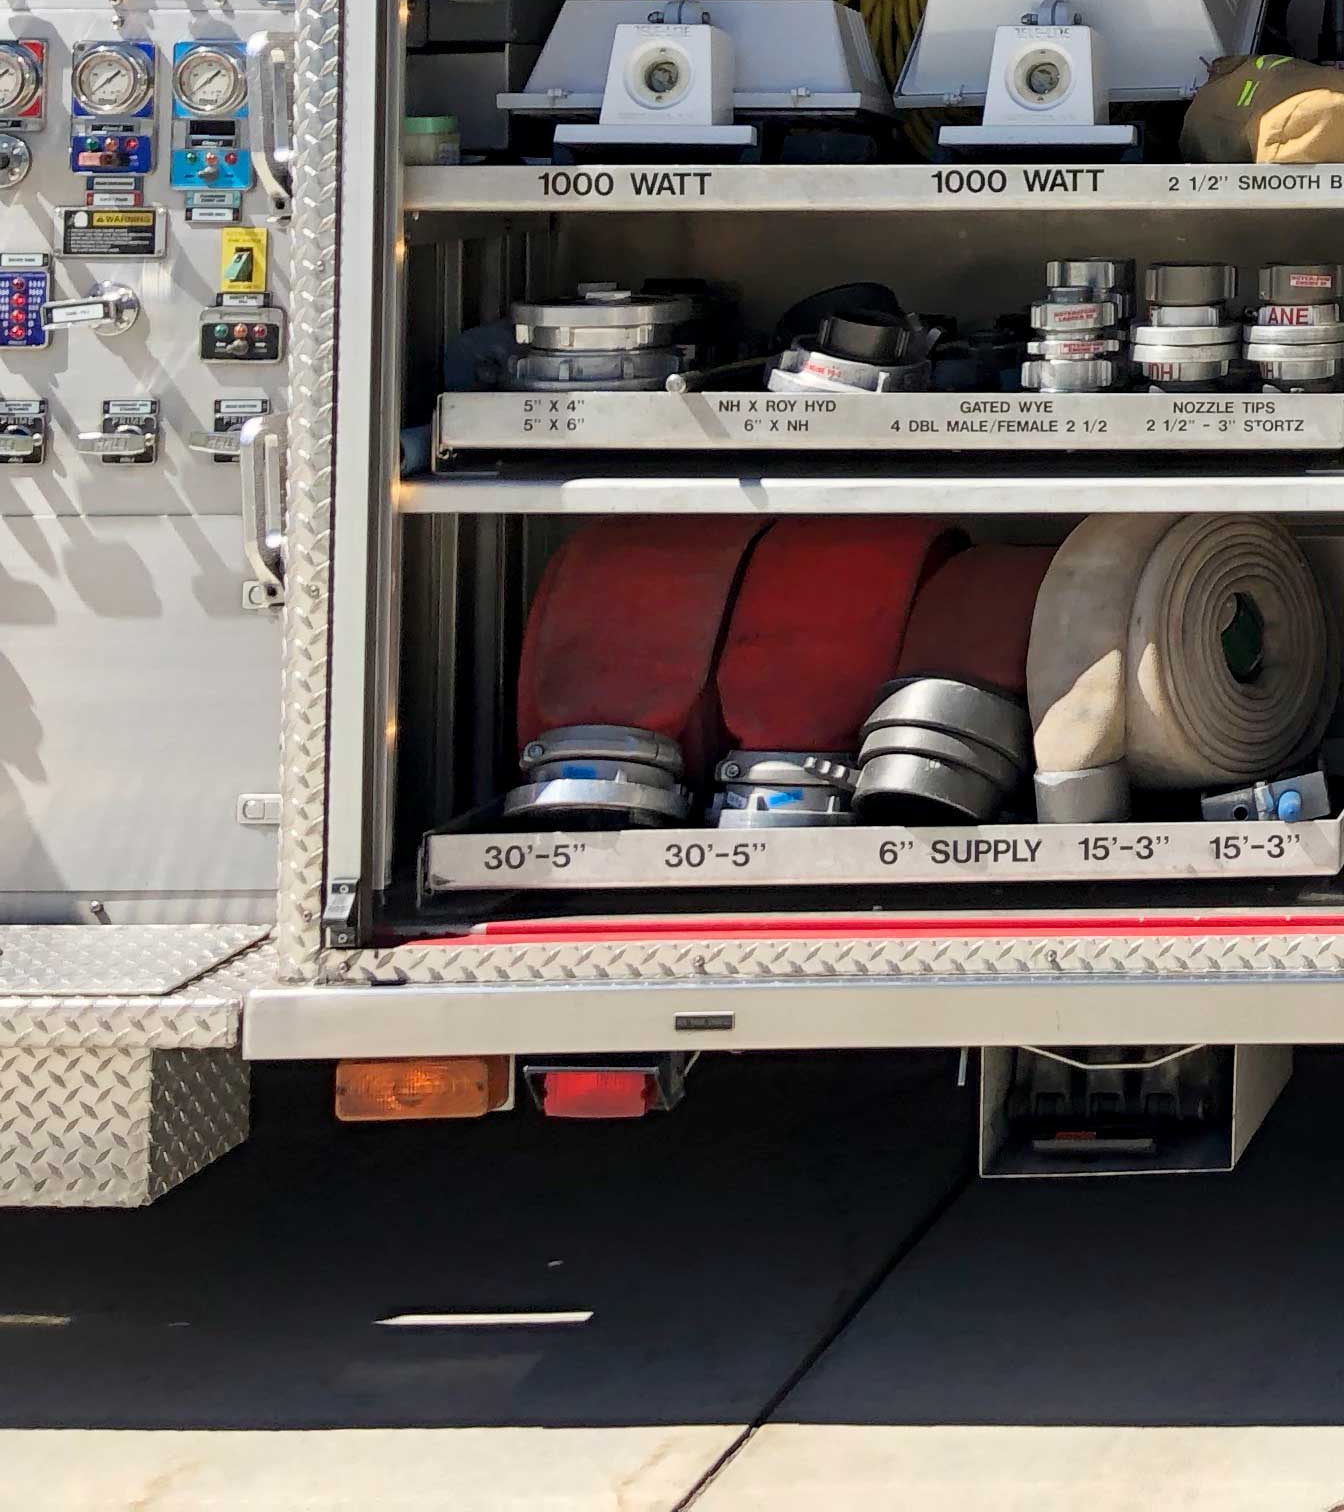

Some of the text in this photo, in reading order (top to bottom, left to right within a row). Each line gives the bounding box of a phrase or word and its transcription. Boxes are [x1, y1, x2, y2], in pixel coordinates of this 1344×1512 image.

[537, 171, 712, 197] 1000 WATT
[931, 168, 1105, 194] 1000 WATT
[1168, 176, 1180, 192] 2
[1238, 174, 1321, 191] SMOOTH
[548, 400, 560, 413] X
[718, 399, 837, 413] NH X ROY HYD
[959, 400, 1053, 414] GATED WYE
[1172, 401, 1276, 415] NOZZLE TIPS
[548, 419, 560, 432] X
[769, 419, 780, 432] X
[787, 419, 809, 432] NH
[890, 419, 1108, 433] 4 DBL MALE/FEMALE 2 1/2
[1146, 418, 1156, 432] 2
[1243, 419, 1305, 433] STORTZ
[931, 839, 1042, 864] SUPPLY
